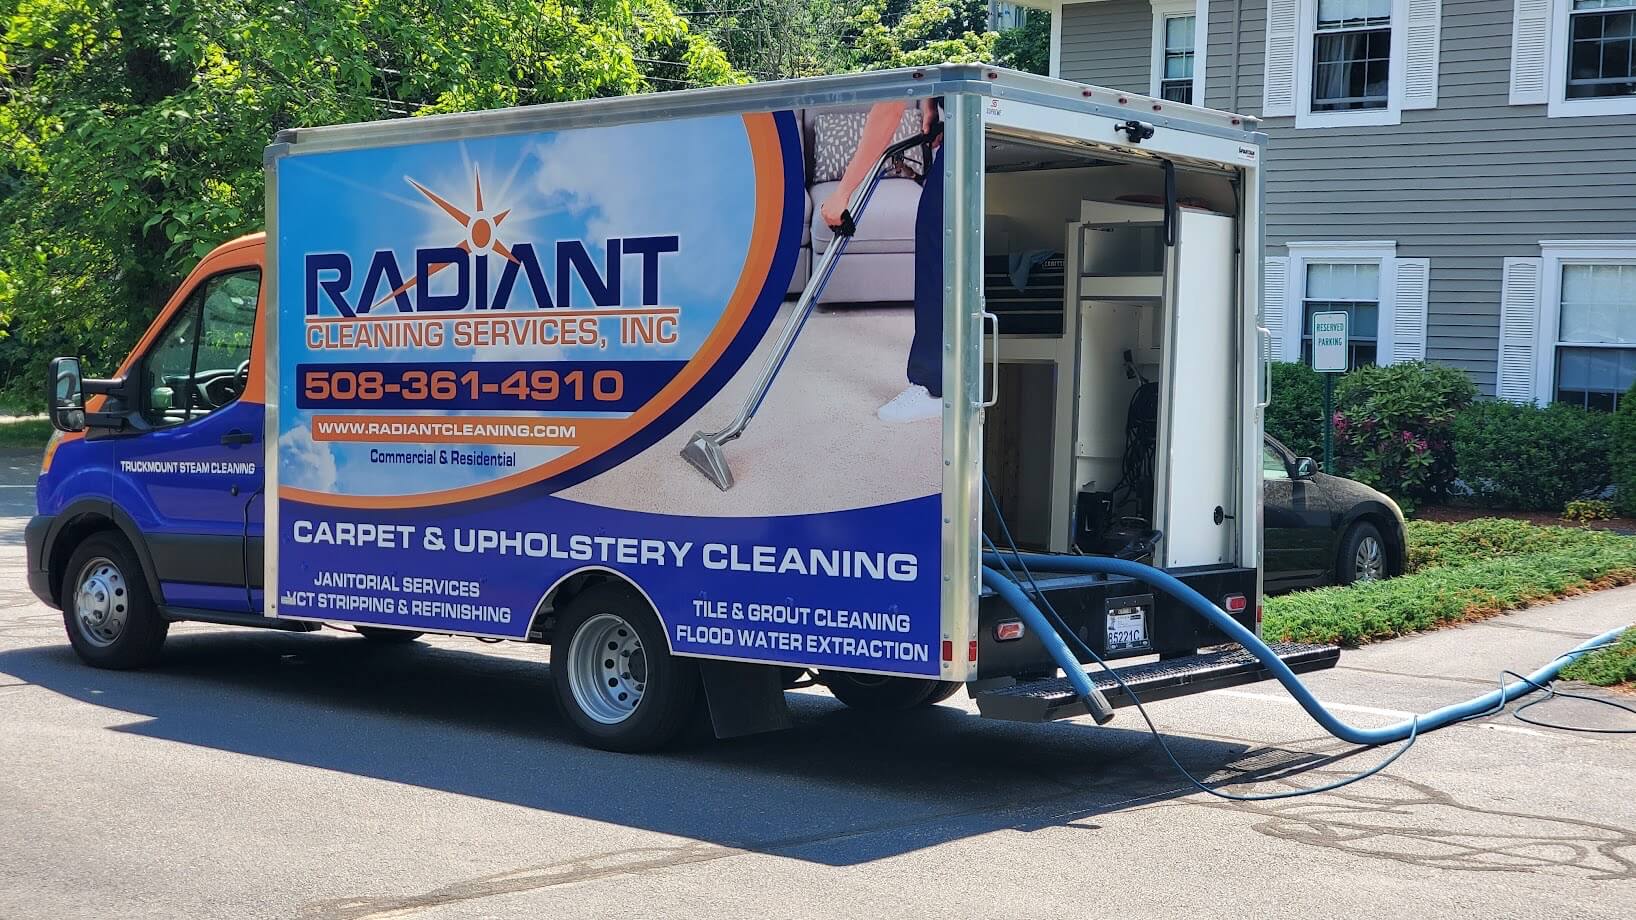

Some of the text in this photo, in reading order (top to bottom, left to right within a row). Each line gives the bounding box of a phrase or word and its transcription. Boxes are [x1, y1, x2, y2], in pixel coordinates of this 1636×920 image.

[305, 236, 679, 317] RADIANT
[307, 315, 678, 349] CLEANING SERVICES, INC
[1316, 323, 1344, 332] RESERVED
[1318, 337, 1342, 346] PARKING
[304, 370, 624, 401] 508-361-4910
[318, 421, 576, 439] WWW.RADIANTCLEANING.COM
[120, 460, 255, 474] TRUCKMOUNT STEAM CLEANING
[370, 448, 516, 467] Commercial & Residential
[293, 519, 918, 582] CARPET & UPHOLSTERY CLEANING
[314, 571, 480, 598] JANITORIAL SERVICES
[318, 593, 394, 614] STRIPPING
[398, 598, 409, 615] &
[411, 600, 511, 623] REFINISHING
[692, 600, 910, 633] TILE & GROUT CLEANING
[676, 625, 928, 662] FLOOD WATER EXTRACTION
